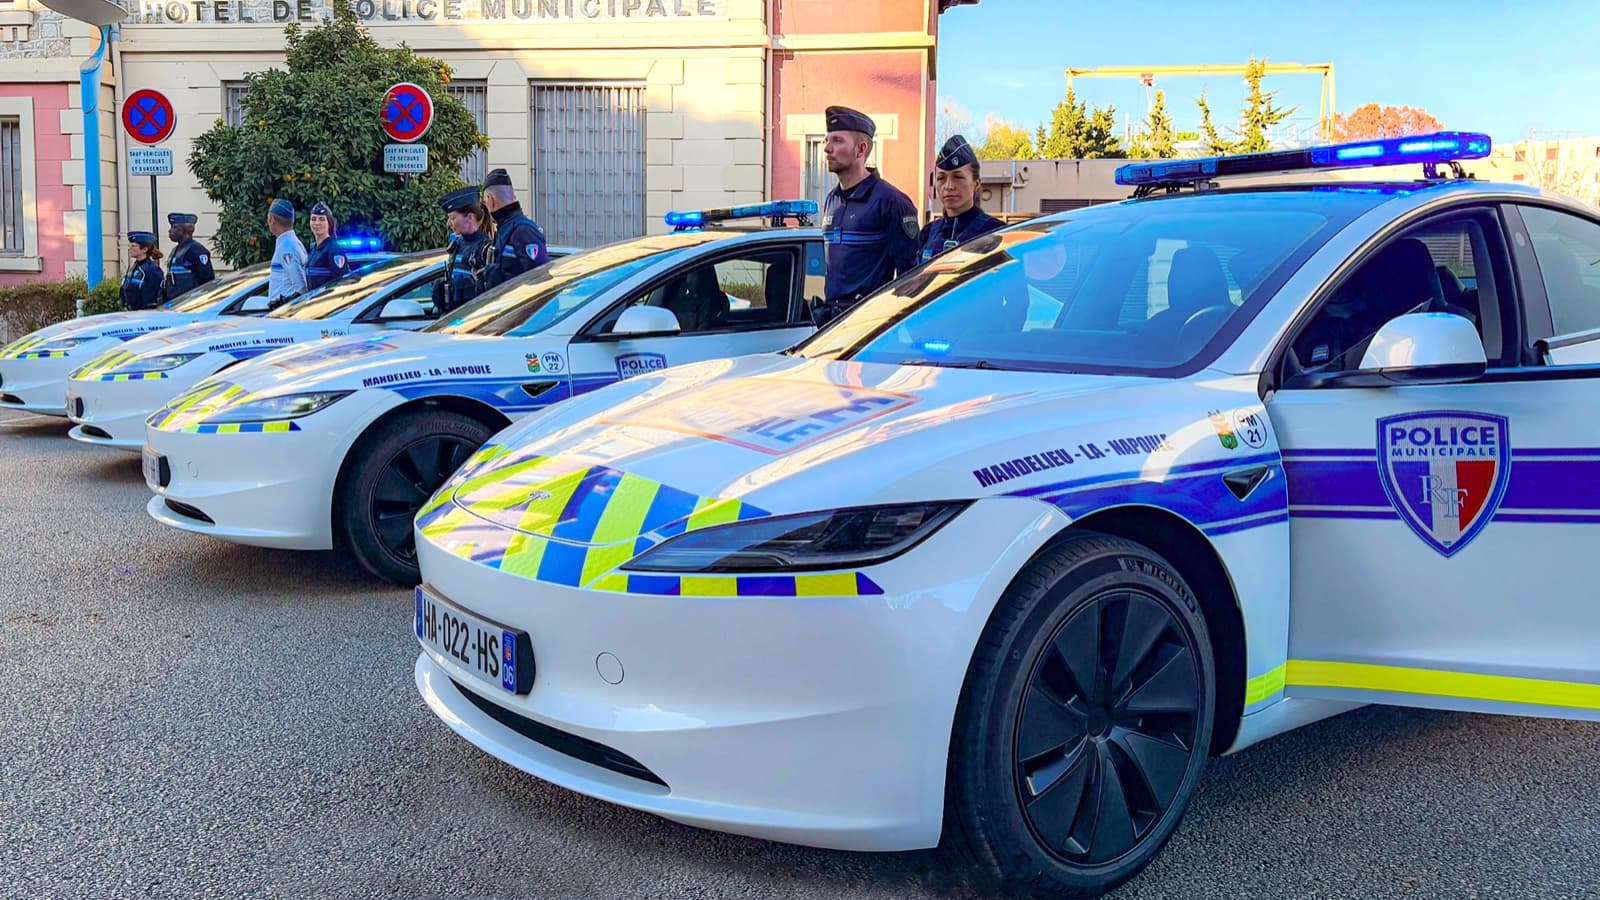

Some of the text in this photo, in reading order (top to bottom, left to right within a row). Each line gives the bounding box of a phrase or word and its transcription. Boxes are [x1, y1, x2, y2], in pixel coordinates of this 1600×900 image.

[272, 0, 313, 20] DE
[333, 0, 461, 20] OLICE
[481, 0, 716, 19] MUNICIPALE
[621, 359, 662, 370] POLICE
[362, 369, 421, 387] MANDELIEU
[428, 368, 442, 377] LA
[448, 364, 492, 375] NAPOULE
[1247, 428, 1262, 443] 21
[1390, 427, 1496, 446] POLICE
[1391, 447, 1497, 457] MUNICIPALE
[973, 448, 1074, 488] MANDELIEU
[1078, 442, 1106, 460] LA
[423, 598, 500, 678] HA-022-HS
[503, 663, 514, 684] 06
